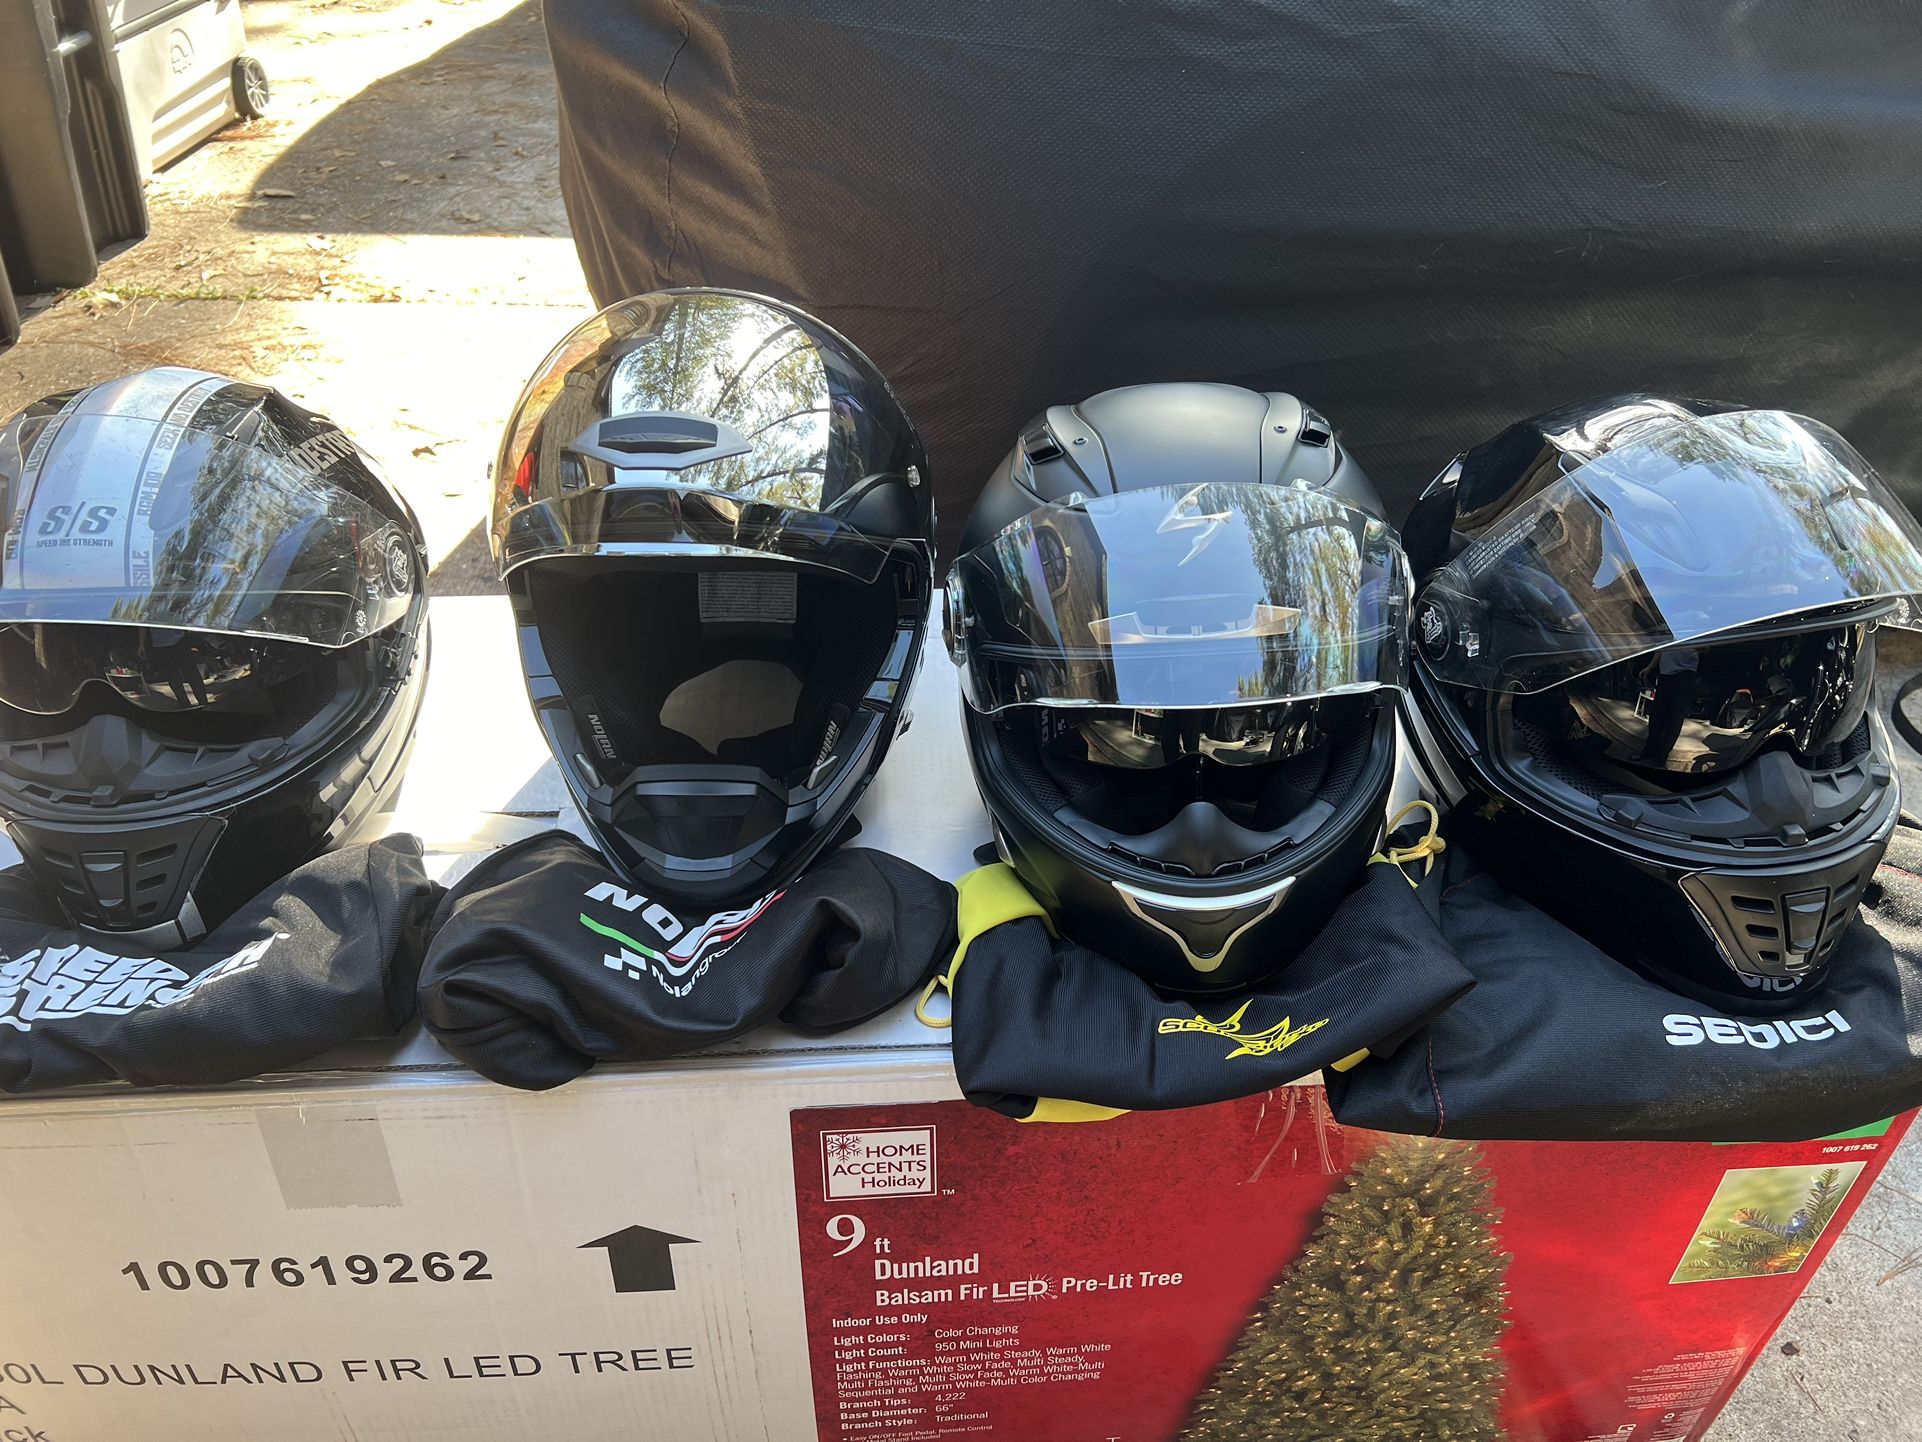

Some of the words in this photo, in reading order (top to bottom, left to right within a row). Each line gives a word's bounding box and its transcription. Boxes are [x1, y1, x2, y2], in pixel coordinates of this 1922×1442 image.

[38, 501, 118, 537] S/S
[72, 538, 114, 547] STRENGTH
[1662, 1009, 1852, 1050] SEDICI
[865, 1143, 927, 1158] HOME
[1822, 1146, 1843, 1154] 1007
[1843, 1144, 1860, 1152] 619
[832, 1160, 927, 1176] ACCENTS
[861, 1176, 926, 1190] Holiday
[825, 1214, 866, 1258] 9
[874, 1237, 891, 1254] ft
[120, 1249, 494, 1293] 1007619262
[875, 1253, 979, 1280] Dunland
[876, 1287, 953, 1306] Balsam
[960, 1283, 988, 1300] Fir
[992, 1279, 1049, 1299] LED
[1061, 1275, 1133, 1293] Pre-Lit
[1139, 1271, 1183, 1287] Tree
[832, 1317, 872, 1328] Indoor
[875, 1315, 898, 1325] Use
[902, 1313, 928, 1324] Only
[834, 1336, 864, 1347] Light
[868, 1333, 910, 1343] Colors:
[935, 1328, 963, 1338] Color
[966, 1324, 1019, 1335] Changing
[835, 1349, 865, 1360] Light
[868, 1346, 908, 1357] Count:
[935, 1341, 957, 1351] 950
[960, 1339, 983, 1349] Mini
[986, 1337, 1020, 1348] Lights
[836, 1361, 865, 1373] Light
[869, 1358, 930, 1370] Functions:
[935, 1354, 967, 1364] Warm
[970, 1351, 1001, 1361] White
[1004, 1348, 1042, 1360] Steady,
[1046, 1346, 1077, 1356] Warm
[1081, 1342, 1111, 1352] White
[72, 1360, 324, 1386] DUNLAND
[342, 1357, 429, 1383] FIR
[445, 1353, 543, 1379] LED
[558, 1346, 696, 1374] TREE
[837, 1370, 885, 1381] Flashing,
[888, 1367, 920, 1377] Warm
[923, 1364, 954, 1374] White
[957, 1362, 982, 1372] Slow
[986, 1359, 1014, 1370] Fade,
[1017, 1357, 1044, 1367] Multi
[1047, 1354, 1086, 1365] Steady,
[838, 1380, 865, 1390] Multi
[868, 1377, 916, 1388] Flashing,
[919, 1374, 946, 1384] Multi
[950, 1371, 975, 1381] Slow
[978, 1368, 1006, 1379] Fade,
[1009, 1366, 1040, 1377] Warm
[1043, 1361, 1105, 1374] White-Multi
[838, 1388, 894, 1399] Sequential
[898, 1385, 918, 1394] and
[922, 1382, 952, 1392] Warm
[955, 1376, 1017, 1389] White-Multi
[1021, 1374, 1049, 1385] Color
[1050, 1371, 1101, 1382] Changing
[839, 1399, 881, 1409] Branch
[884, 1397, 911, 1407] Tips:
[935, 1392, 966, 1403] 4,222
[840, 1411, 869, 1420] Base
[872, 1407, 928, 1418] Diameter:
[935, 1403, 954, 1412] 66"
[841, 1421, 882, 1430] Branch
[885, 1418, 918, 1428] Style:
[935, 1411, 988, 1422] Traditional
